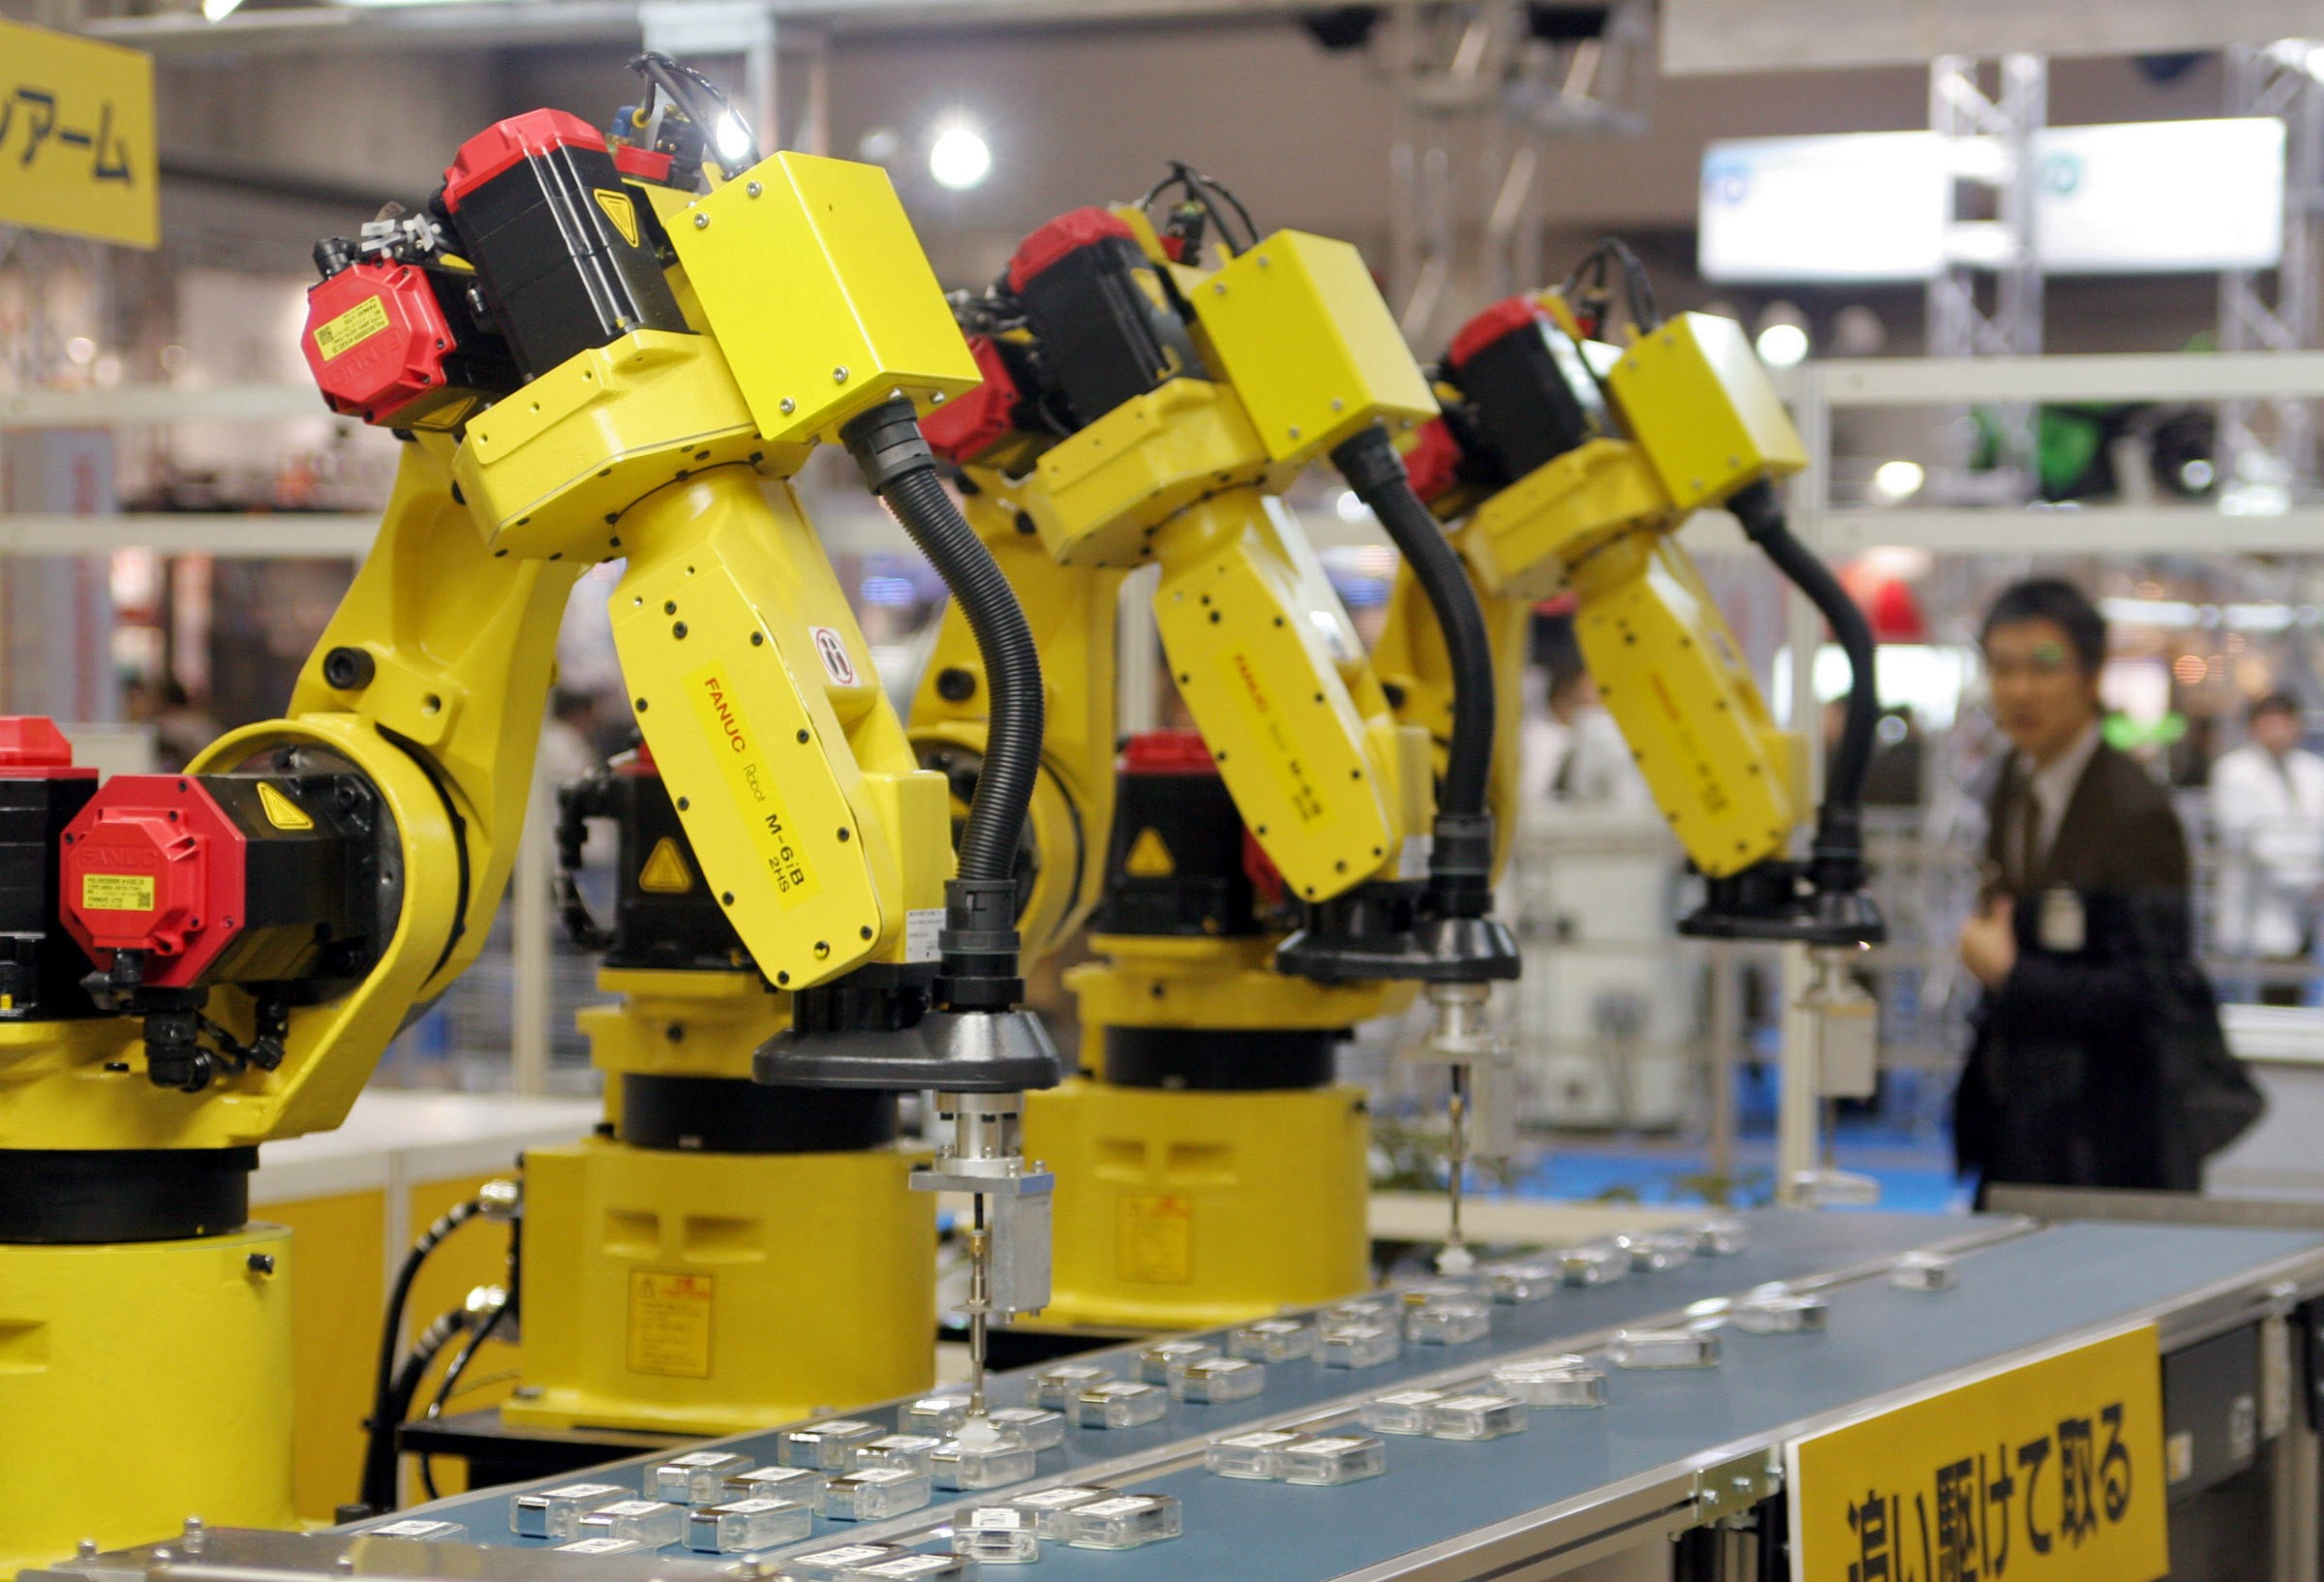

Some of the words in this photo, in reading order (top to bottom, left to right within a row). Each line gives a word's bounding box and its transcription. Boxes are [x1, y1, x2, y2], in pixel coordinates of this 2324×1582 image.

[705, 677, 746, 753] FANUC
[743, 763, 767, 803] Robot
[765, 813, 805, 886] M-6iB
[79, 847, 157, 867] FANUC
[768, 856, 790, 893] 2HS
